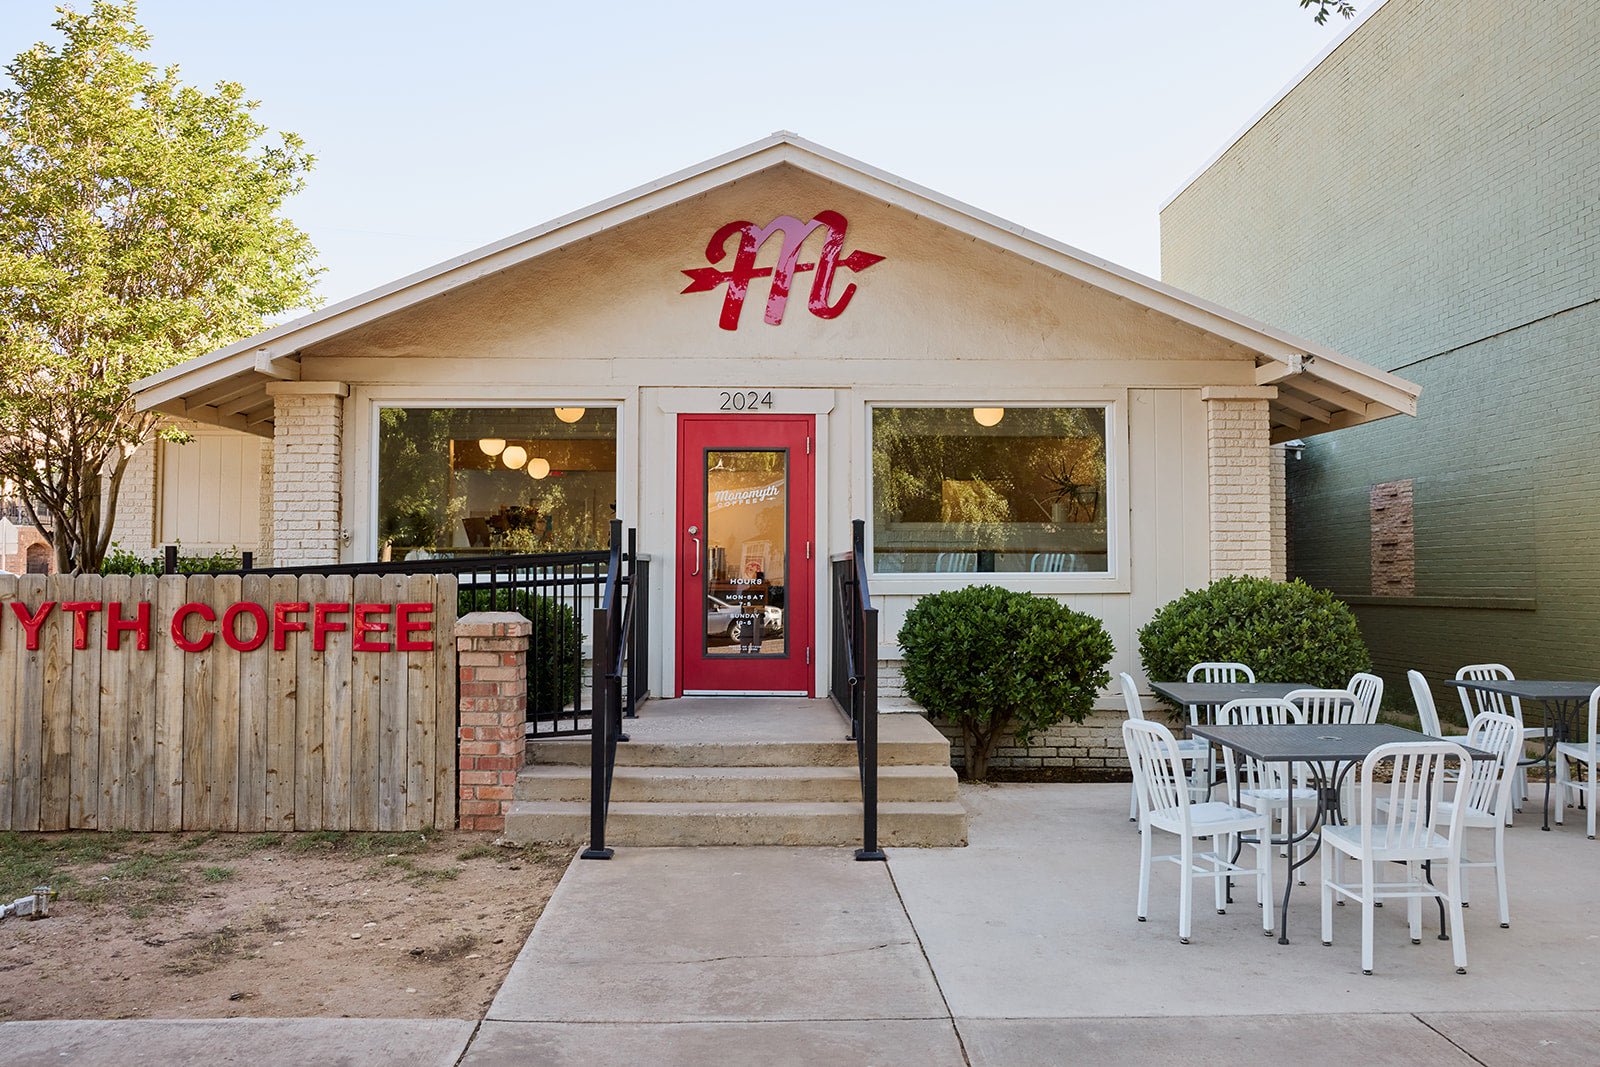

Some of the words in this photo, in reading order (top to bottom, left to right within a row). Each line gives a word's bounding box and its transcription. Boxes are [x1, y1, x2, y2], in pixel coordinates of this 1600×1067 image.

[719, 391, 773, 411] 2024
[714, 485, 780, 502] Monomyth
[717, 498, 758, 508] COFFEE
[0, 602, 152, 651] YTH
[171, 602, 434, 652] COFFEE
